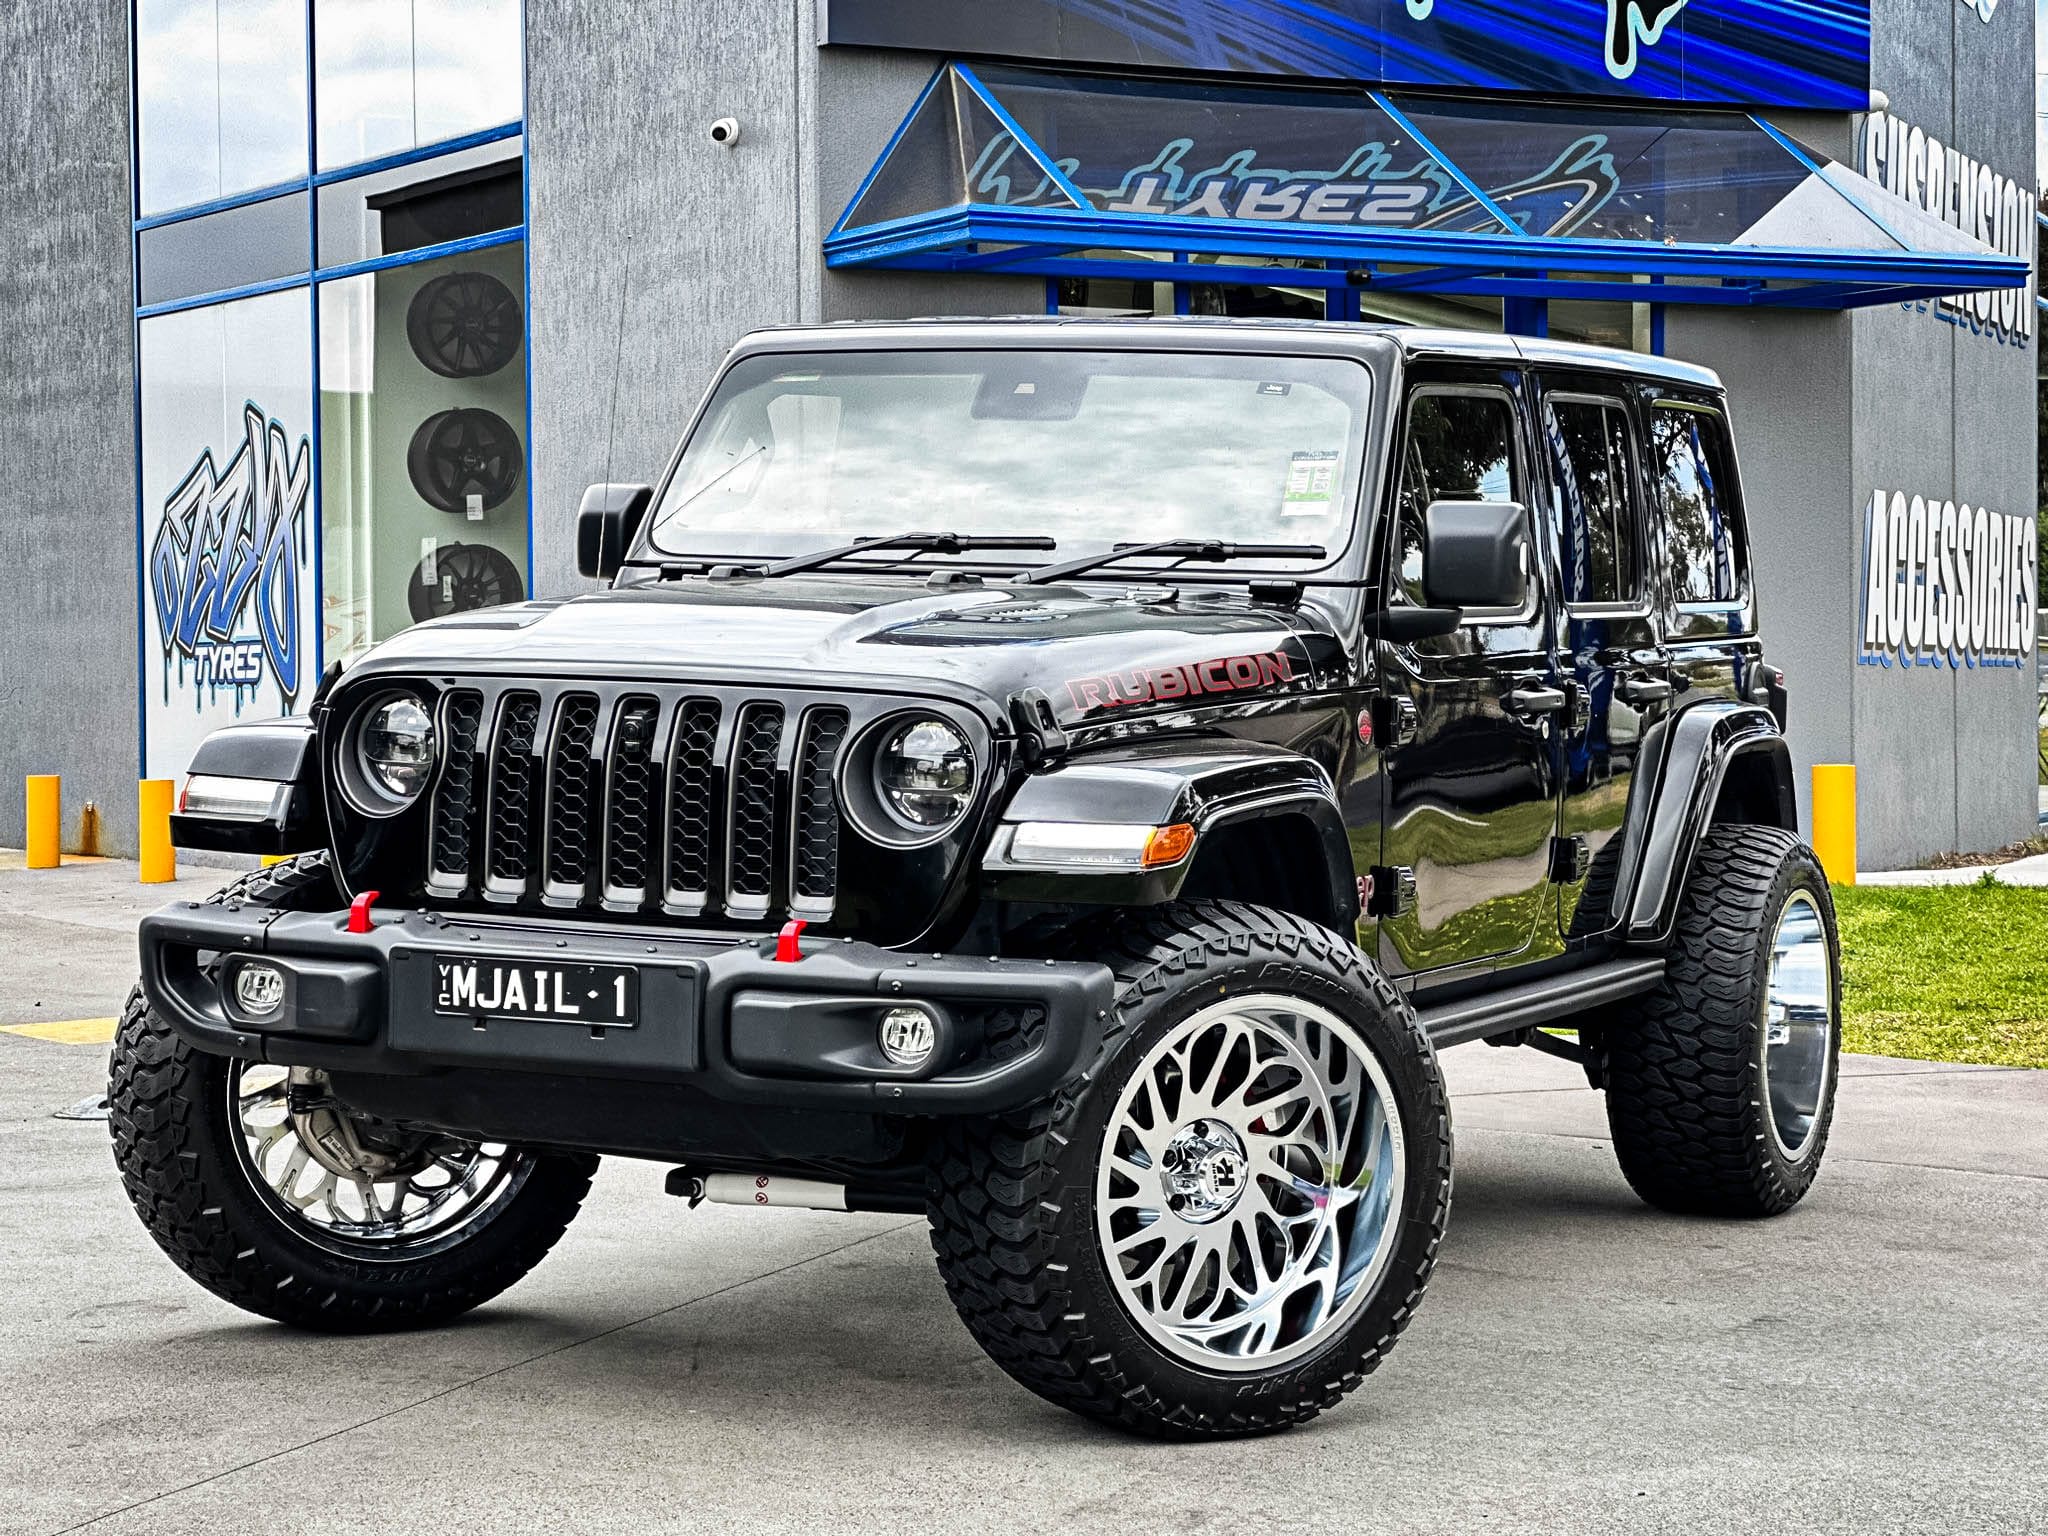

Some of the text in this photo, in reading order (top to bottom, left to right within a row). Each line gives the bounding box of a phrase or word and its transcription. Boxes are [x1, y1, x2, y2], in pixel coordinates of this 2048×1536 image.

[1863, 489, 2035, 658] ACCESSORIES
[193, 641, 264, 682] TYRES
[1065, 651, 1294, 712] RUBICON
[438, 964, 451, 1006] VIC
[452, 964, 626, 1017] MJAIL 1
